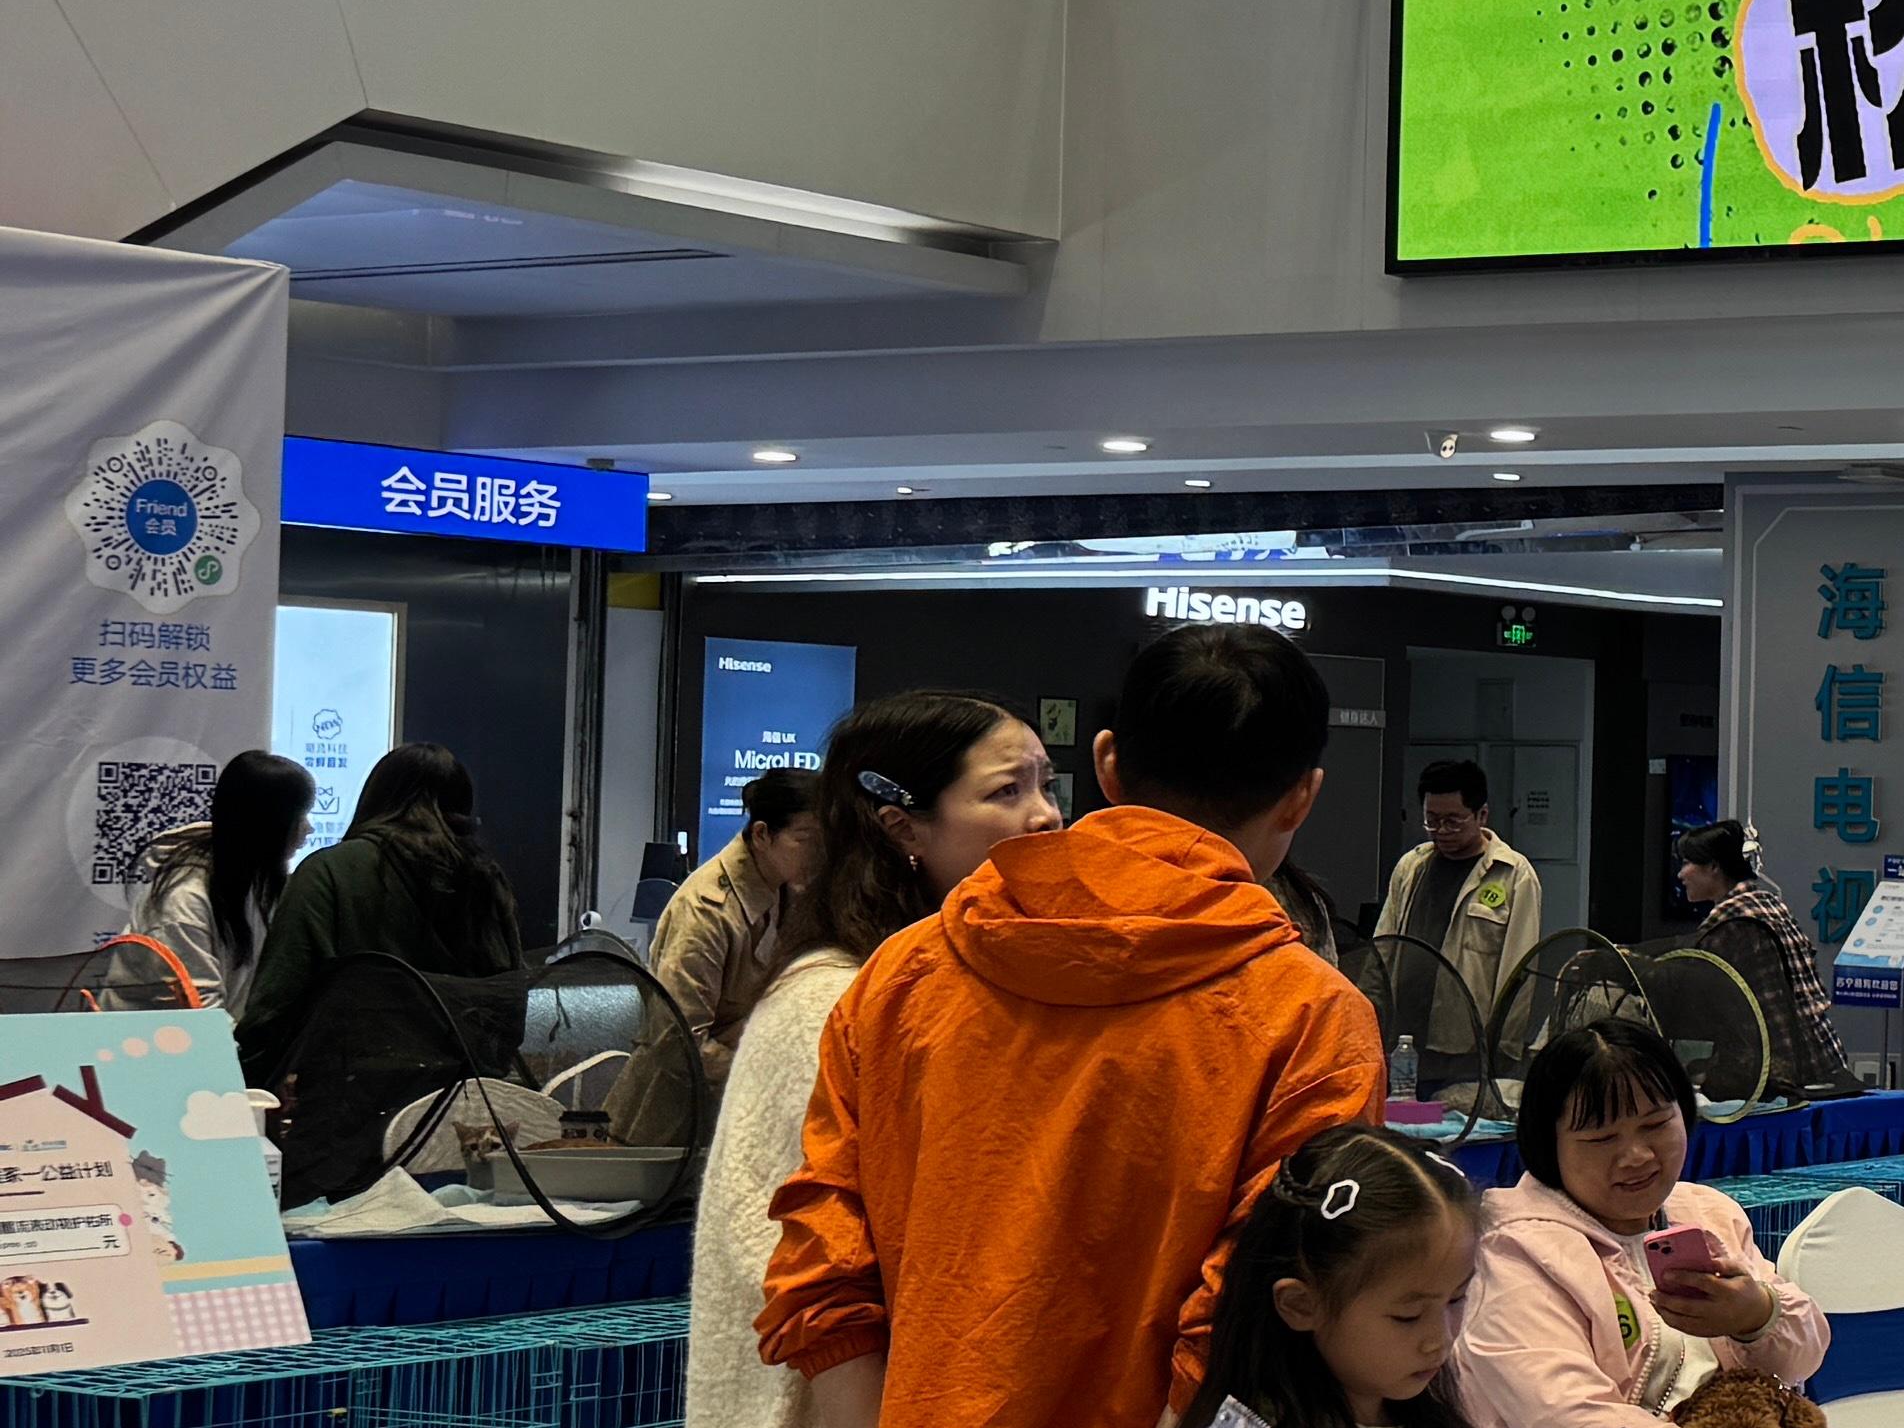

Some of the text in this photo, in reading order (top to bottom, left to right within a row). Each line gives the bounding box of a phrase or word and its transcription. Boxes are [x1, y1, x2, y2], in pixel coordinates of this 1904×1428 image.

[135, 497, 187, 518] Friend
[380, 464, 562, 527] 会员服务
[144, 518, 178, 537] 会员
[1145, 586, 1306, 629] Hisense
[99, 619, 211, 653] 扫码解锁
[70, 656, 238, 692] 更多会员权益
[719, 656, 772, 673] Hisense
[1811, 561, 1888, 946] 海信电视
[102, 1234, 121, 1249] 元
